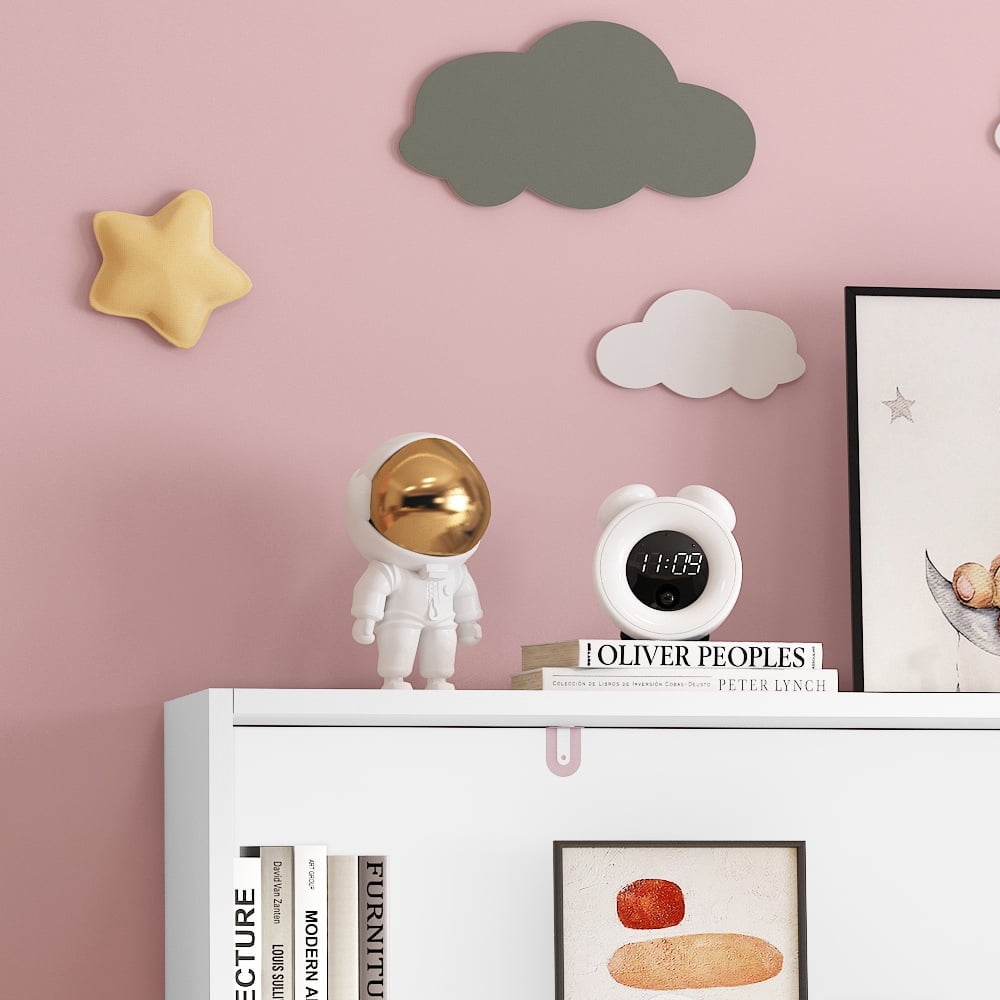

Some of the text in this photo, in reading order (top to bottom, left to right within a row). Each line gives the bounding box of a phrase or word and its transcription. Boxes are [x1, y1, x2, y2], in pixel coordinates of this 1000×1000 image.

[641, 552, 704, 576] 11:09
[597, 644, 691, 666] OLIVER
[697, 645, 805, 668] PEOPLES
[718, 679, 826, 692] PETER LYNCH
[273, 861, 283, 924] David Van Zanten
[272, 944, 284, 971] LOUIS
[305, 910, 318, 981] MODERN
